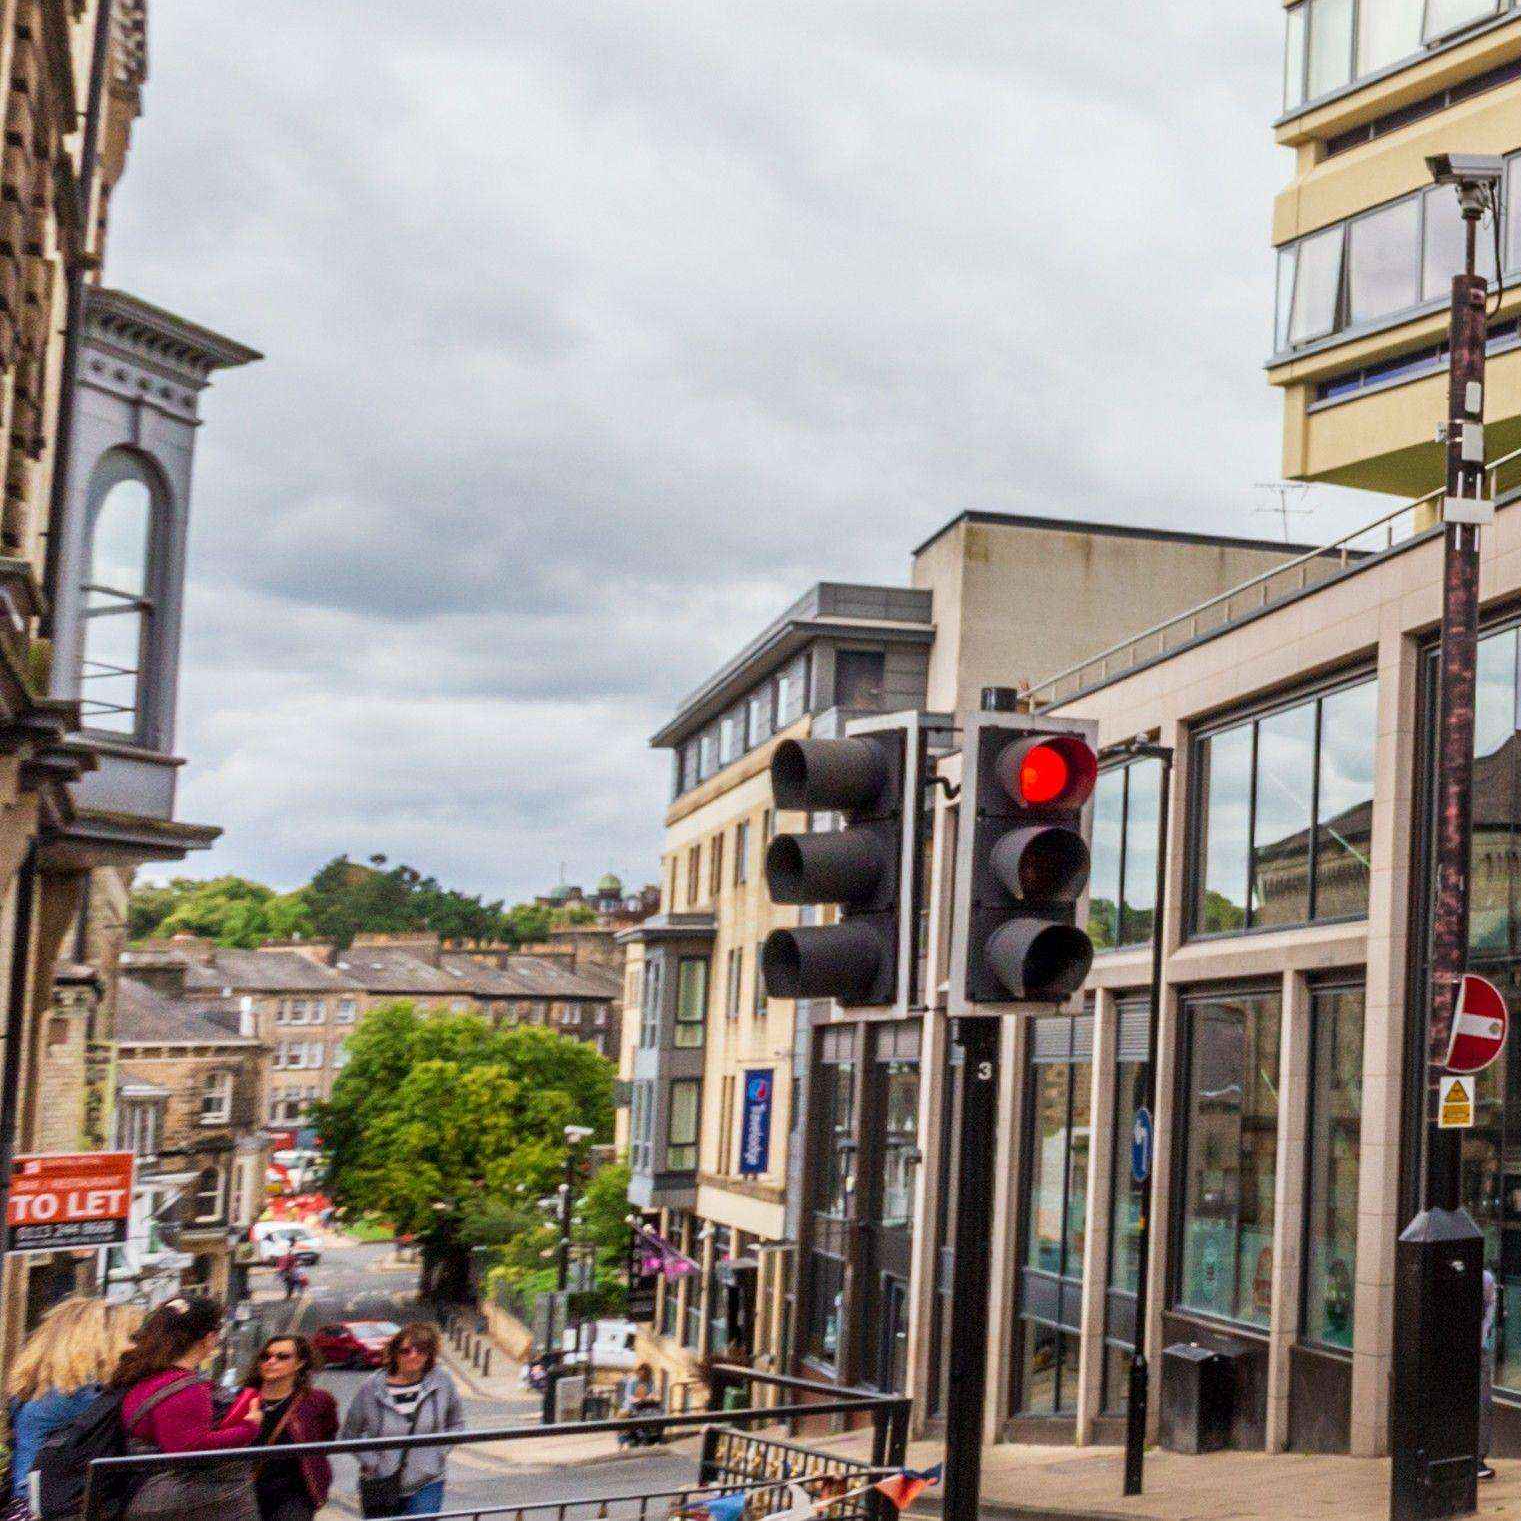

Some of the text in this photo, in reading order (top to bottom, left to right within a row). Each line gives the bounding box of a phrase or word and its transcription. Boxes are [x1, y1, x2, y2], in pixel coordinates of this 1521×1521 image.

[979, 1062, 992, 1080] 3
[9, 1189, 127, 1221] TO LET
